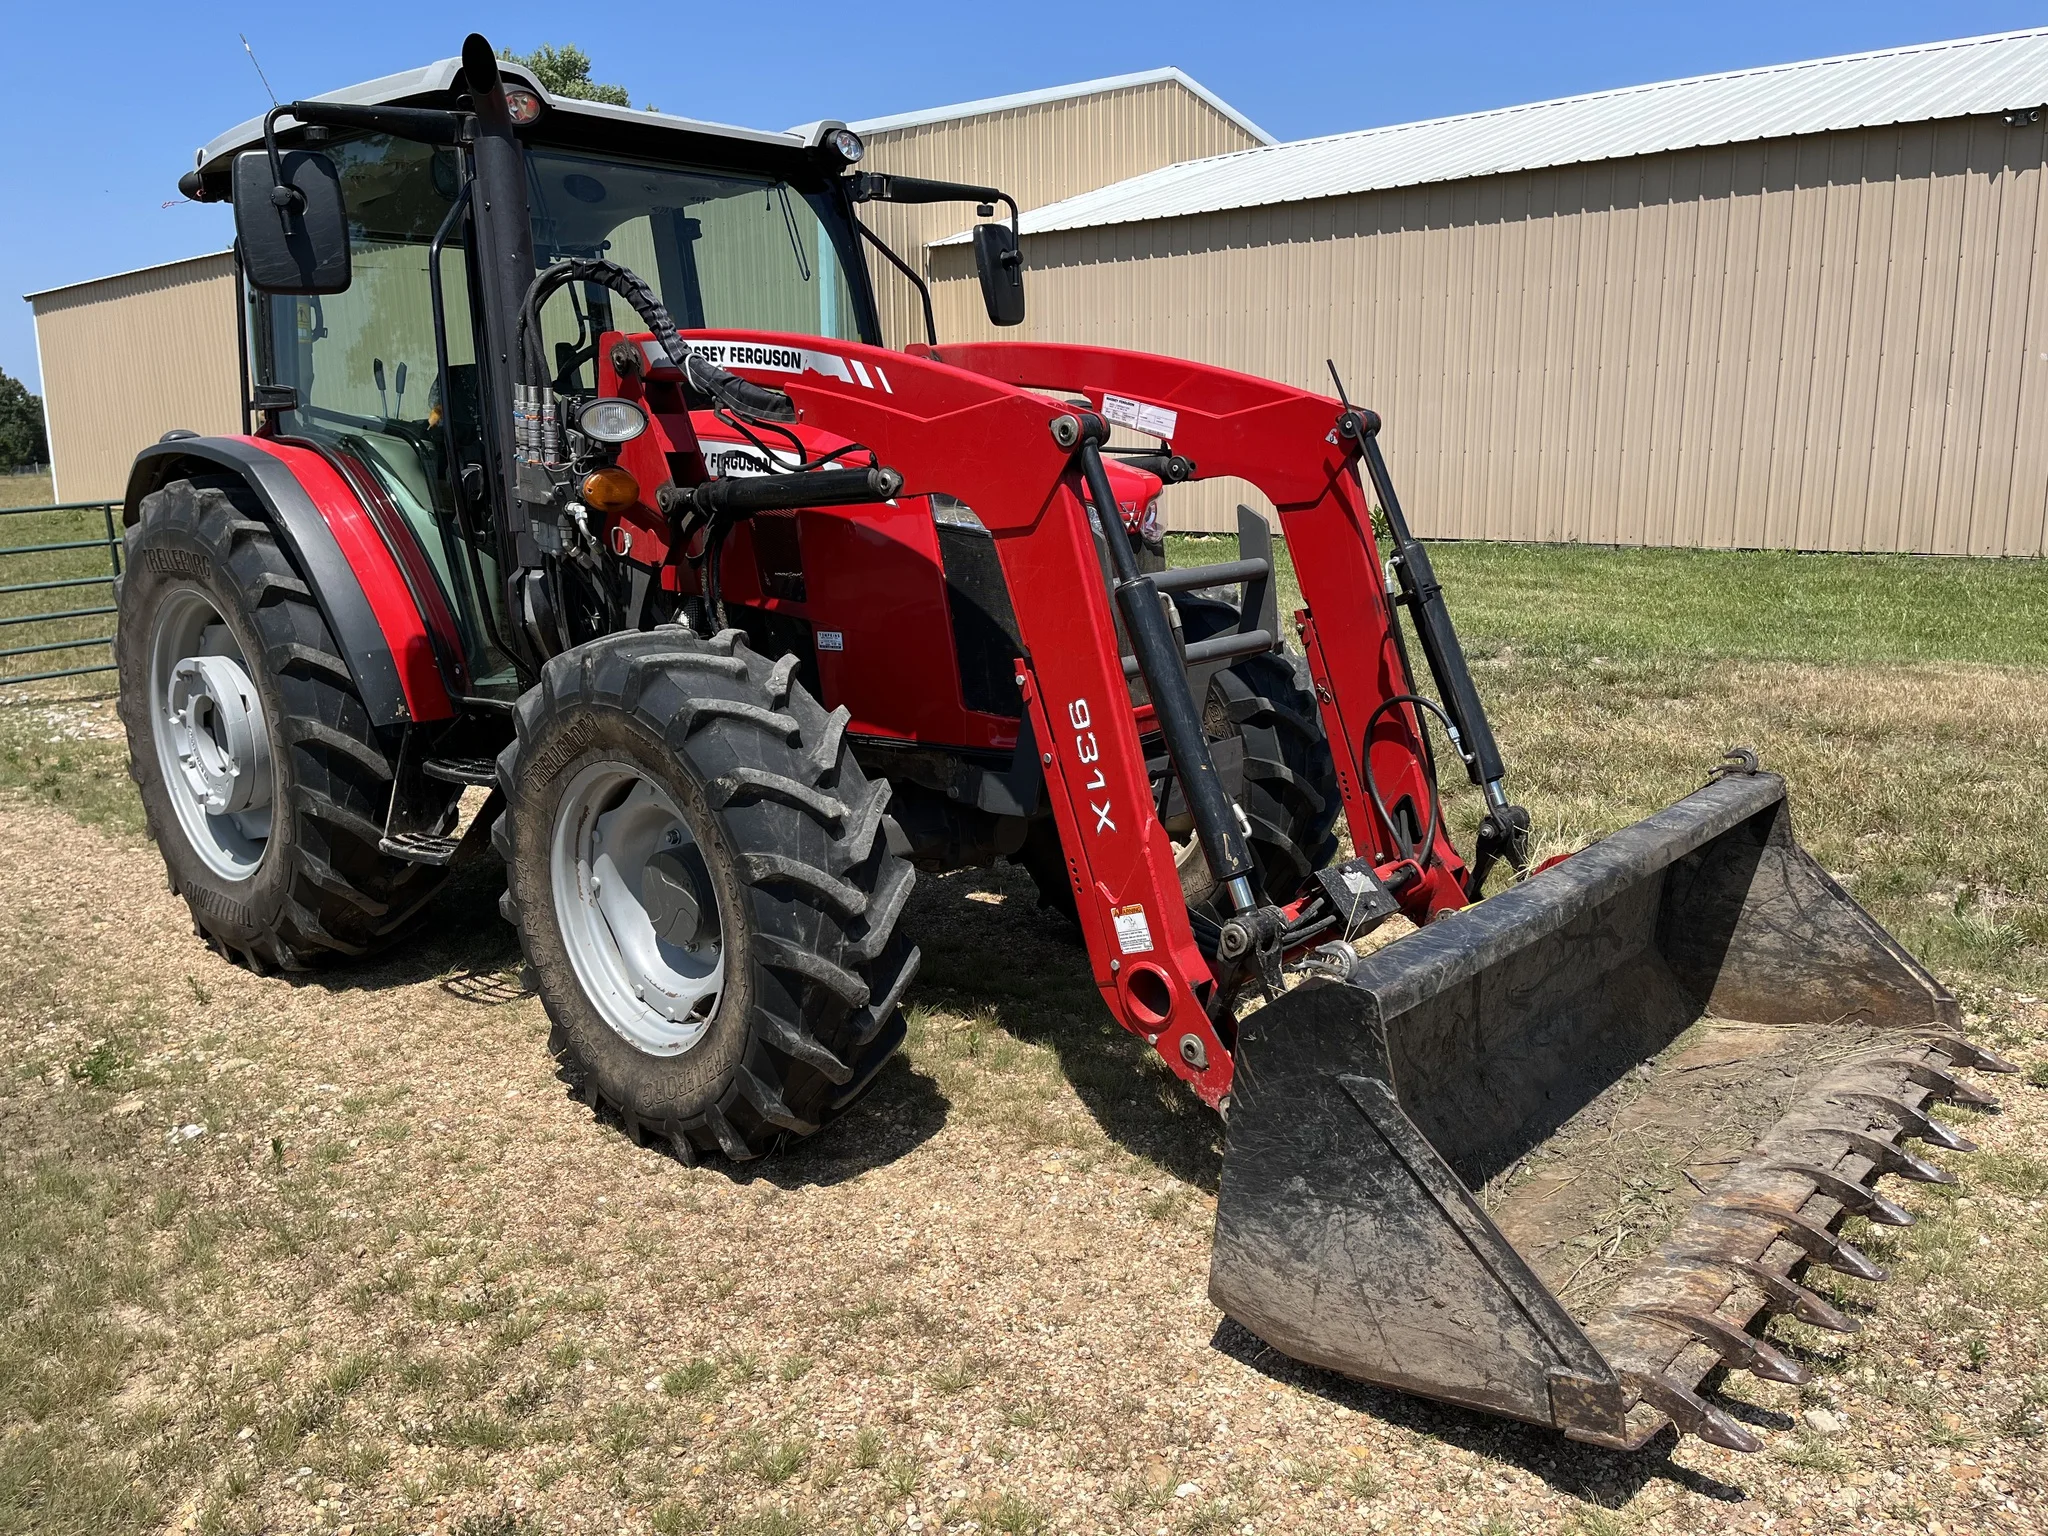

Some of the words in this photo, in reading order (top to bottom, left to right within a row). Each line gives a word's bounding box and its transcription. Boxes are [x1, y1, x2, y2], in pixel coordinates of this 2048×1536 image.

[729, 346, 802, 370] FERGUSON
[142, 549, 211, 579] TRELLEBORG
[523, 712, 601, 792] TRELLEBORG
[186, 881, 254, 929] TRELLEBORG
[643, 1044, 733, 1108] TRELLEBORG
